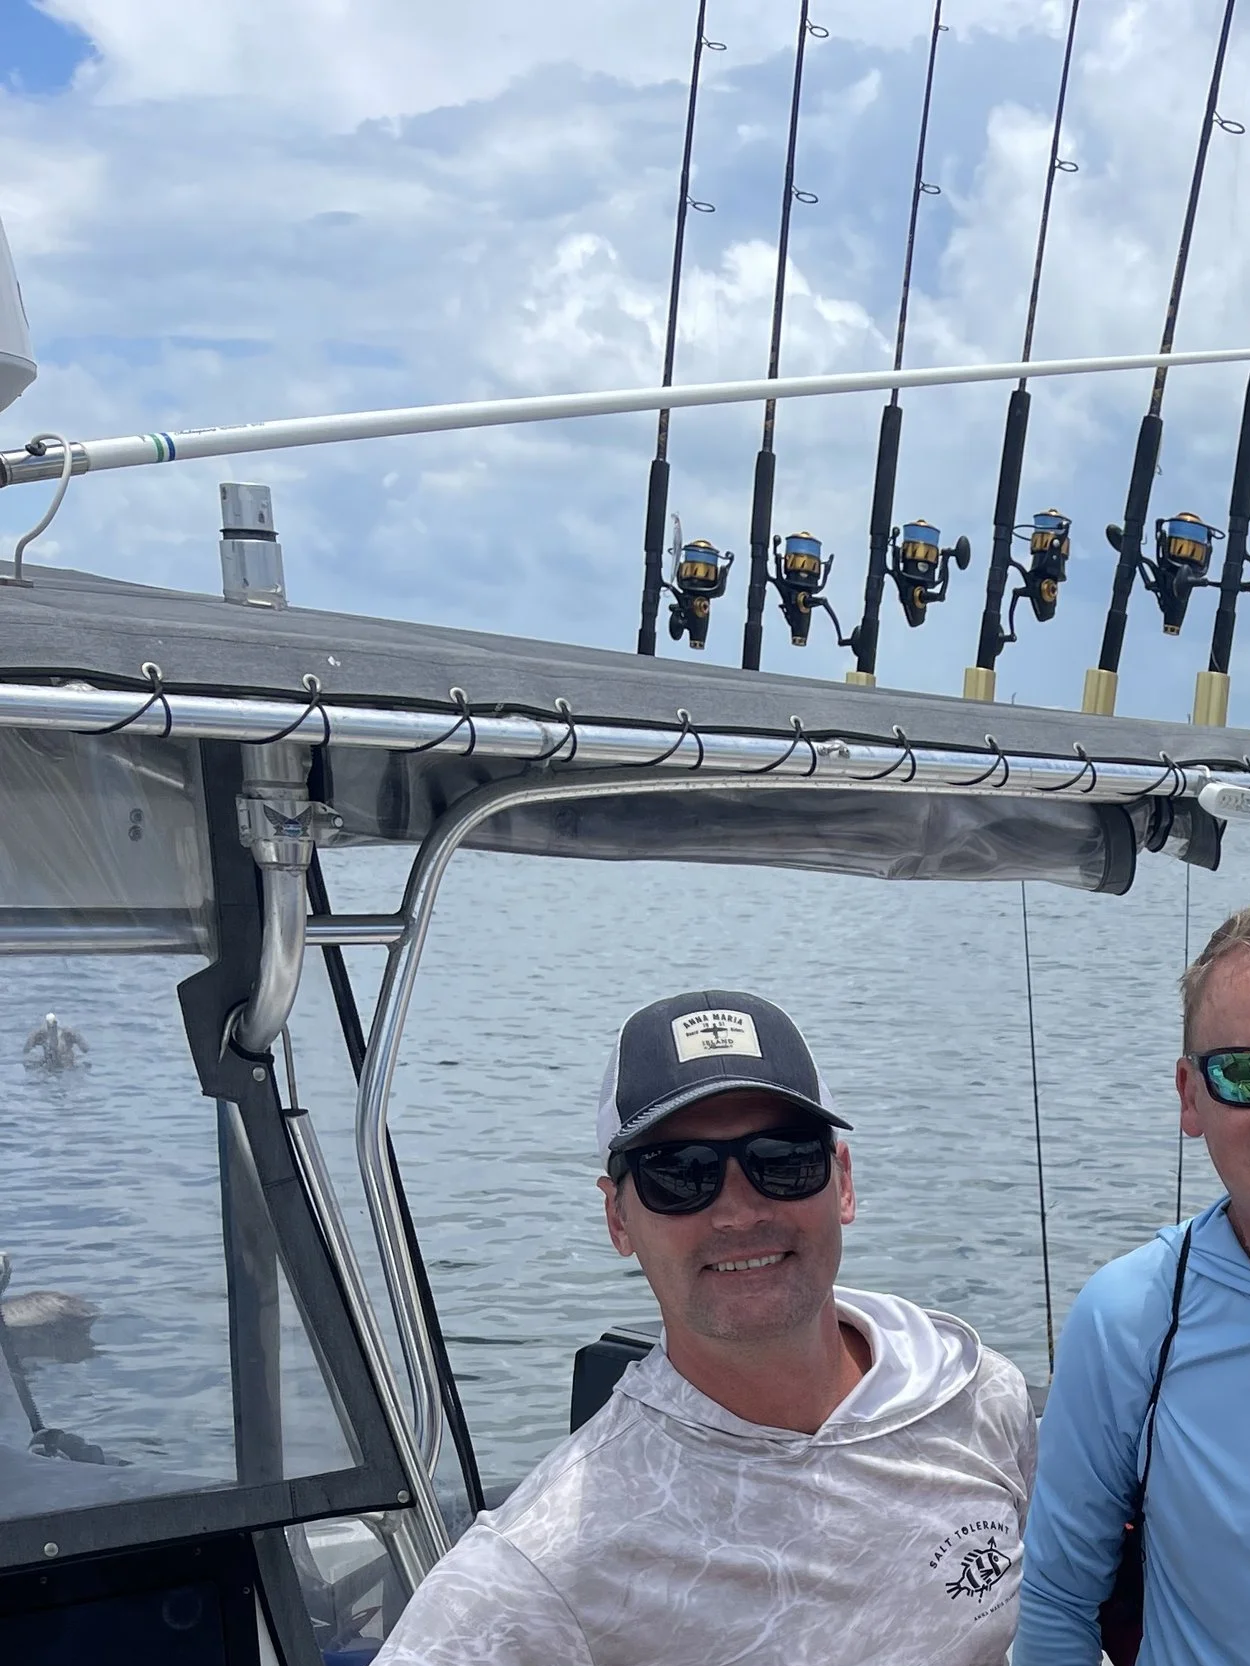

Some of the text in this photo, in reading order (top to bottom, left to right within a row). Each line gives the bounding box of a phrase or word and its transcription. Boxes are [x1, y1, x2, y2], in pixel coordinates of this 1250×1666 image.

[683, 1013, 742, 1029] ANNA MARIA
[702, 1038, 734, 1046] ISLAND
[929, 1520, 1010, 1570] SALT TOLERANT
